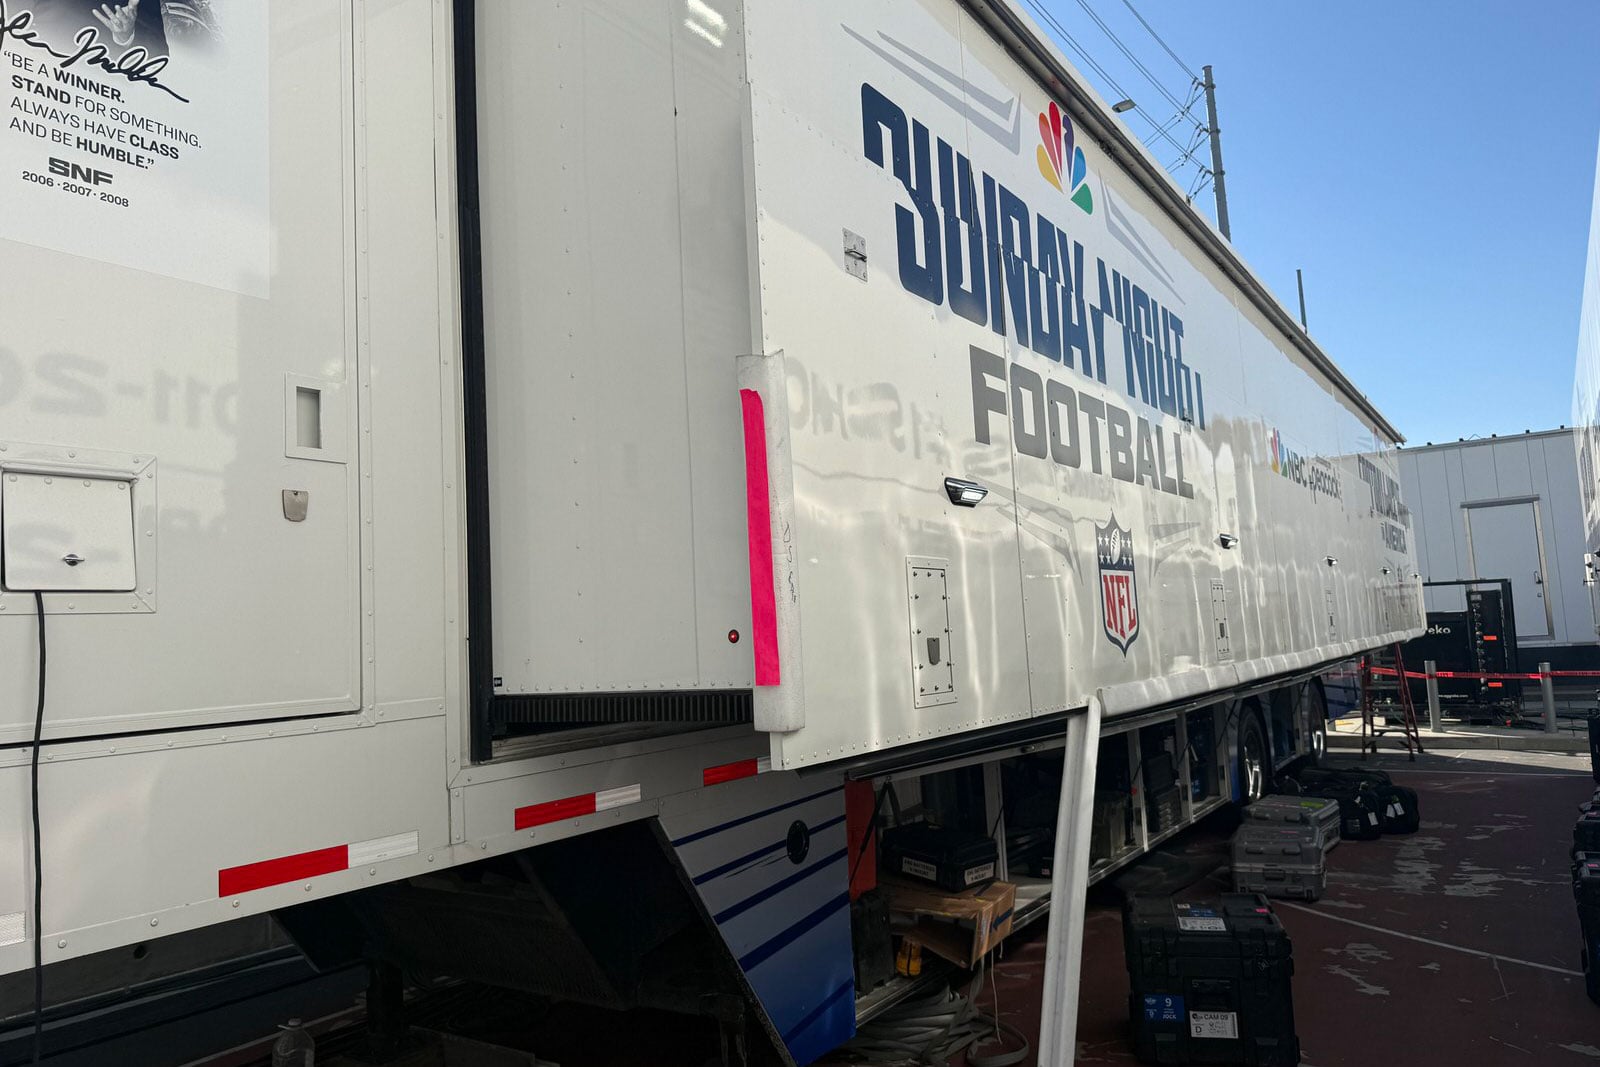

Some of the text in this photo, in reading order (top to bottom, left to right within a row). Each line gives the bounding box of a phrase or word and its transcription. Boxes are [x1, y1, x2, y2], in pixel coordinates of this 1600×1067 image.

[37, 63, 50, 78] A
[53, 67, 125, 103] WINNER.
[9, 117, 47, 139] AND
[51, 131, 72, 147] BE
[10, 96, 179, 160] ALWAYS HAVE CLASS
[11, 75, 202, 149] STAND FOR SOMETHING.
[22, 170, 129, 208] 2006 2007 2008
[48, 156, 114, 186] SNF
[861, 82, 1107, 386] SUNDAY
[1090, 256, 1205, 431] NIGHT
[969, 344, 1194, 500] FOOTBALL
[1286, 447, 1307, 488] NBC
[1102, 573, 1137, 639] NFL
[1164, 997, 1172, 1007] 9
